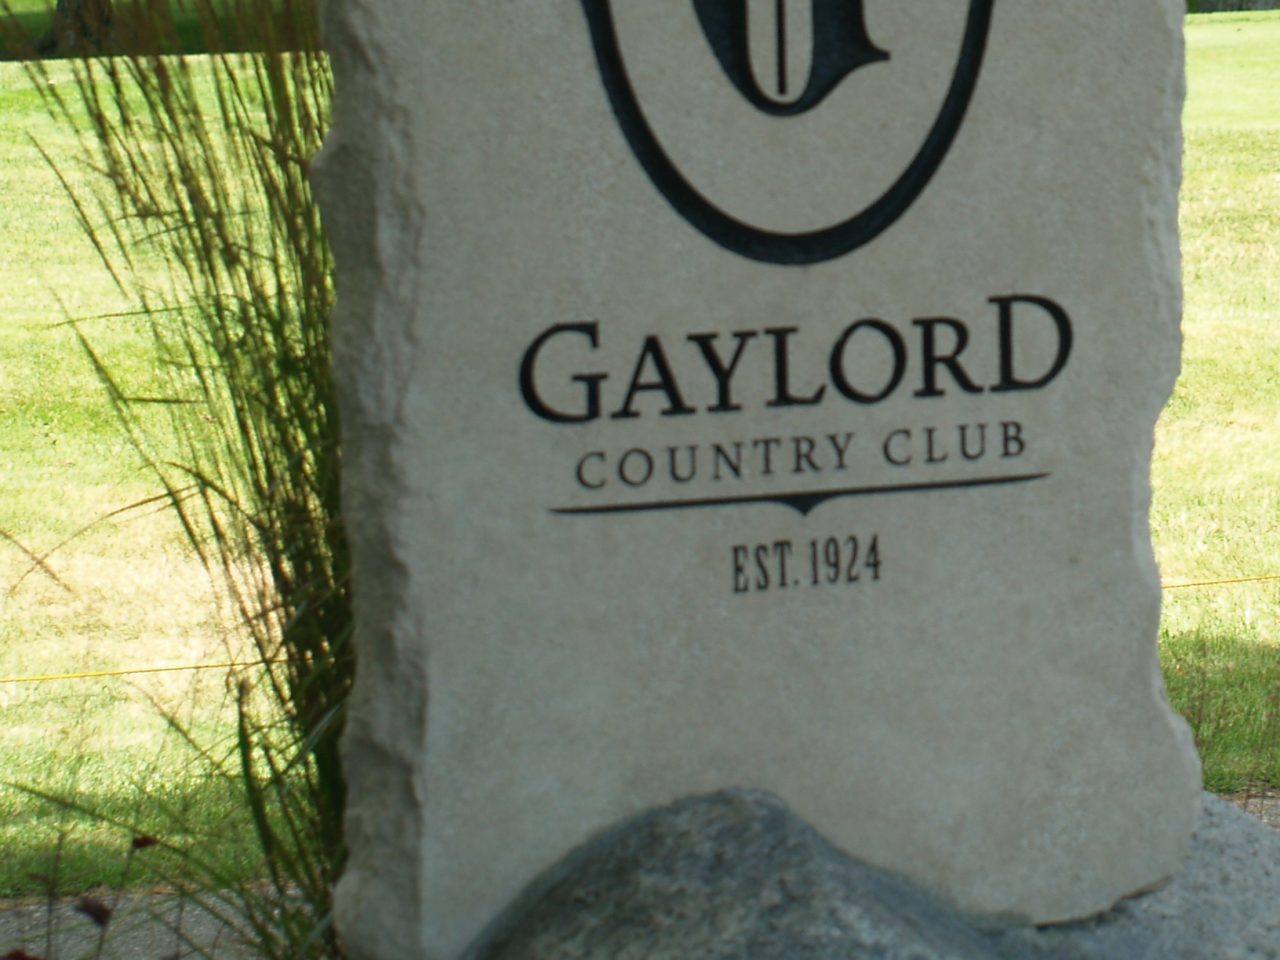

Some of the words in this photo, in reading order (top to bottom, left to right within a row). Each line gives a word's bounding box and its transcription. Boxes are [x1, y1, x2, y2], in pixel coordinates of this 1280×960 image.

[518, 294, 1074, 424] GAYLORD
[575, 432, 856, 491] COUNTRY
[883, 420, 1026, 467] CLUB
[809, 534, 882, 585] 1924
